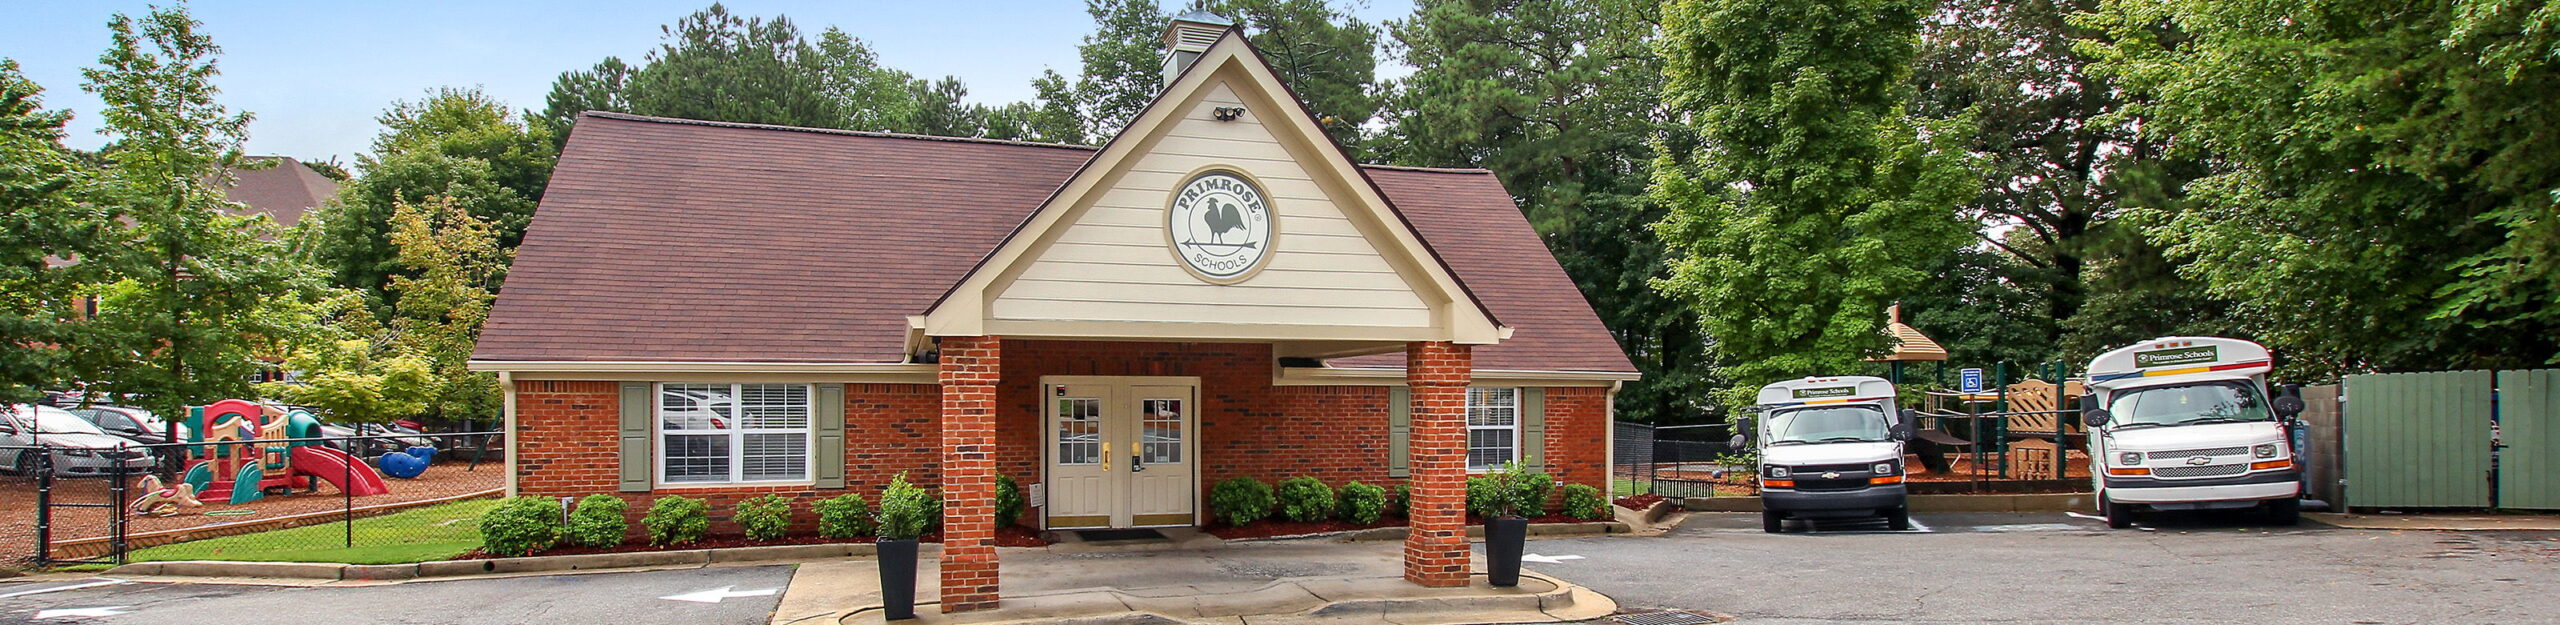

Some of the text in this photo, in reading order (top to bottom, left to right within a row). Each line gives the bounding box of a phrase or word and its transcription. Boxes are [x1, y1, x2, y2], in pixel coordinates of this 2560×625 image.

[1178, 178, 1261, 214] PRIMROSE
[1194, 253, 1247, 271] SCHOOLS
[2149, 353, 2183, 361] Primrose
[2184, 350, 2215, 358] Schools
